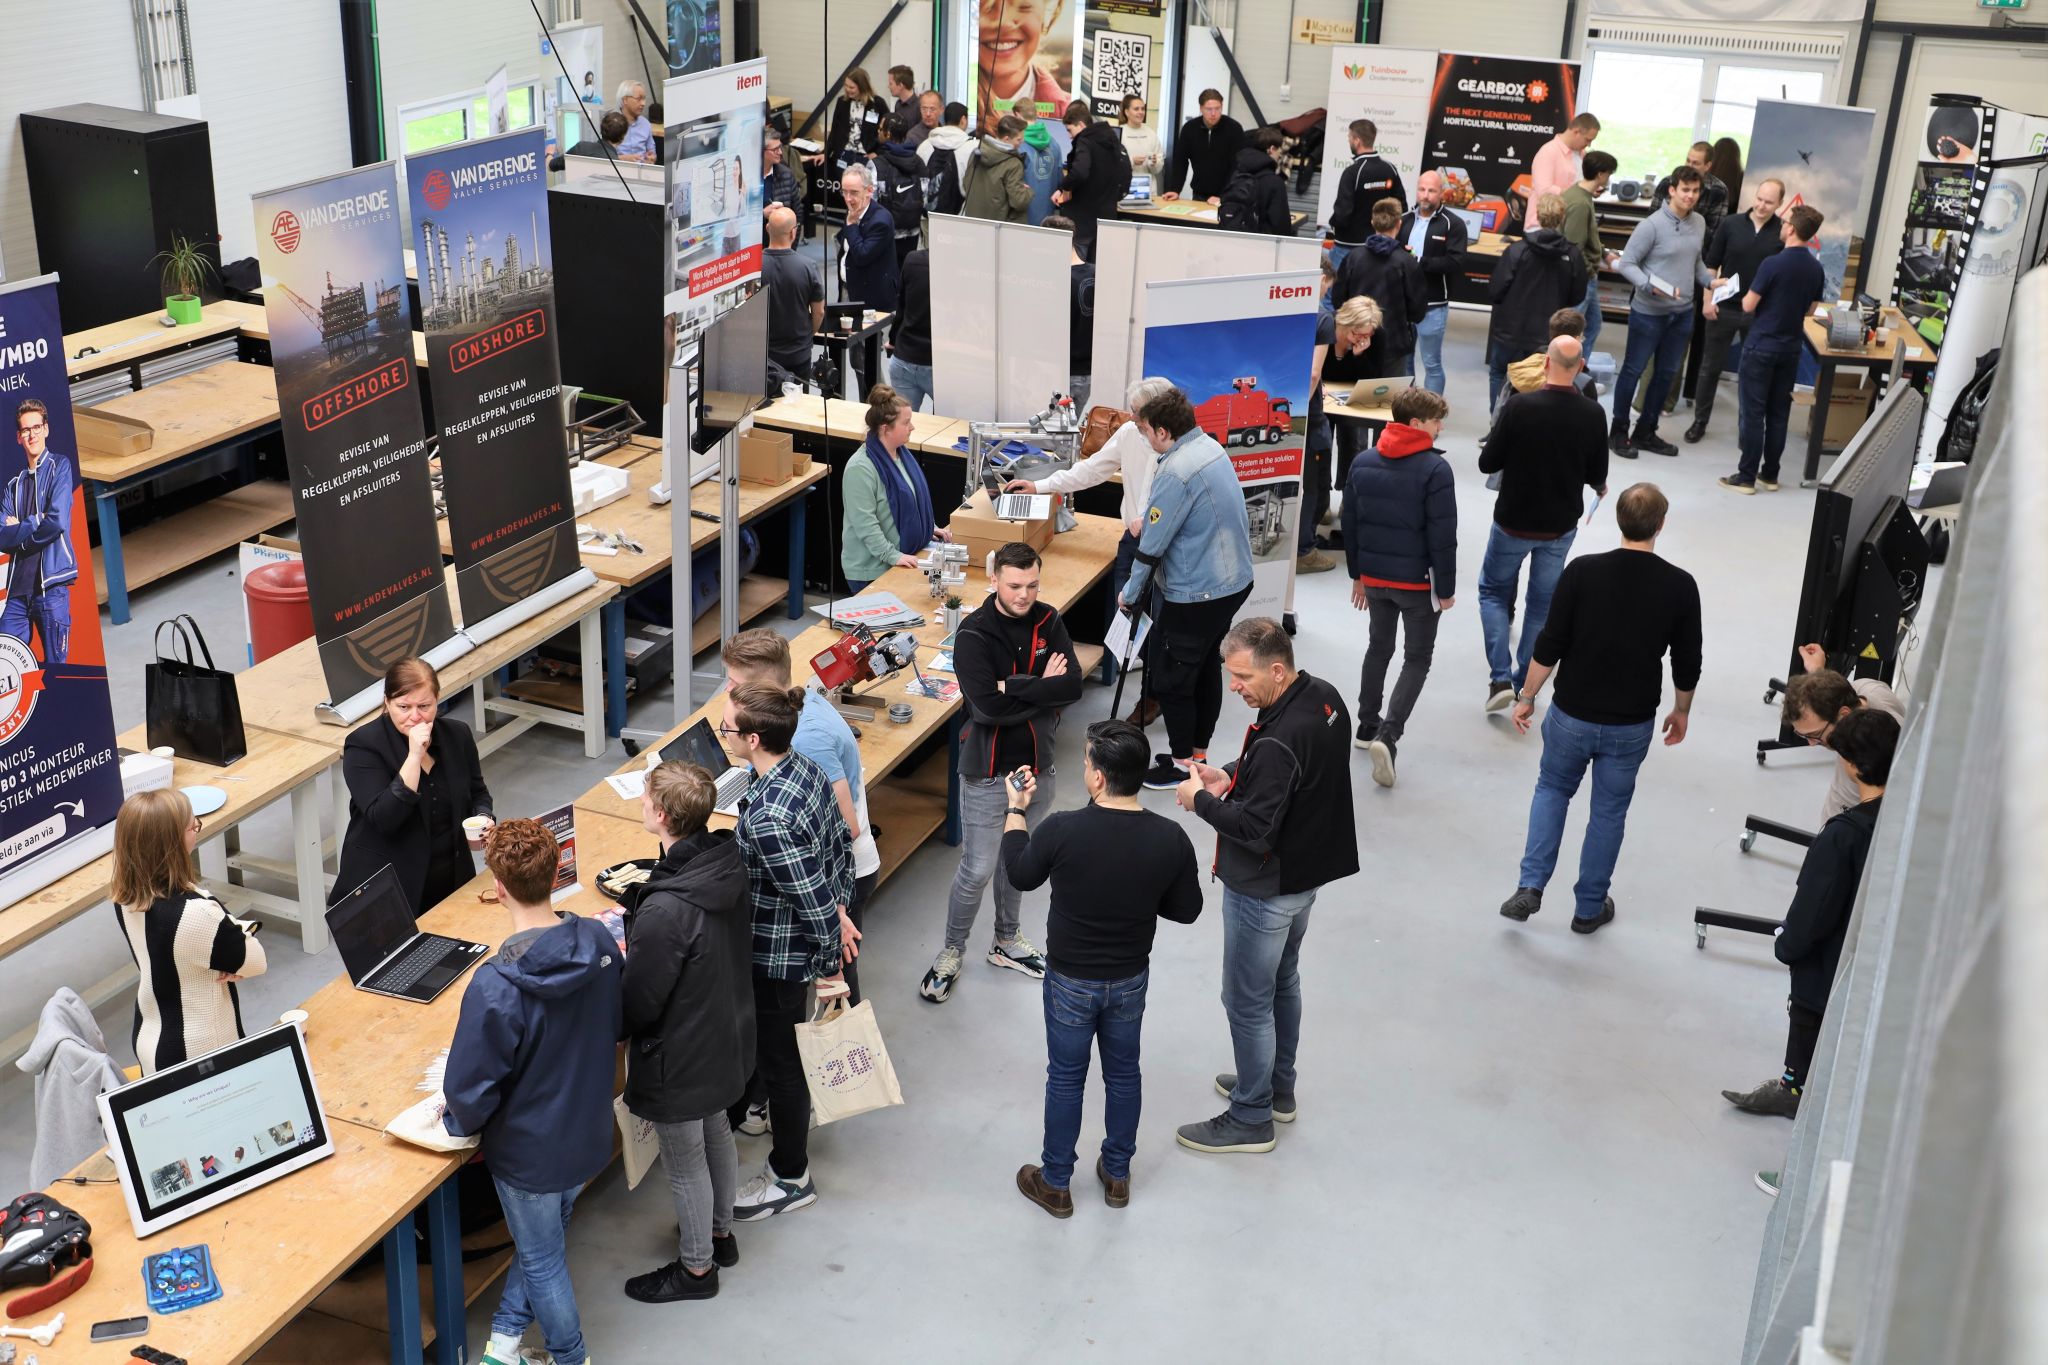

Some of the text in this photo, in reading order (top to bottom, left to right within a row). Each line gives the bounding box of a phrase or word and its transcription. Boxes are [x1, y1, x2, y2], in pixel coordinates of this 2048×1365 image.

[737, 73, 762, 91] item
[1371, 65, 1408, 75] Tuinbouw
[1457, 79, 1526, 96] GEARBOX
[1443, 116, 1554, 134] HORTICULTURAL WORKFORCE
[1445, 106, 1532, 121] THE NEXT GENERATION
[451, 152, 537, 190] VAN DER ENDE
[453, 173, 539, 200] VALVE SERVICES
[301, 190, 390, 230] VAN DER ENDE
[341, 212, 392, 232] SERVICES
[1269, 285, 1312, 300] item
[457, 318, 536, 364] ONSHORE
[311, 366, 401, 421] OFFSHORE
[478, 378, 527, 404] REVISIE VAN
[445, 384, 561, 437] REGELKLEPPEN, VEILIGHEDEN
[477, 412, 536, 444] EN AFSLUITERS
[339, 434, 390, 464] REVISIE VAN
[302, 439, 425, 499] REGELKLEPPEN, VEILIGHEDEN
[340, 471, 401, 507] EN AFSLUITERS
[470, 502, 563, 551] WWW.ENDEVALVES.NL
[334, 566, 433, 622] WWW.ENDEVALVES.NL
[20, 770, 27, 783] 3
[30, 742, 86, 779] MONTEUR
[36, 748, 112, 795] MEDEWERKER
[14, 843, 23, 855] je
[24, 834, 40, 847] aan
[41, 826, 54, 838] via
